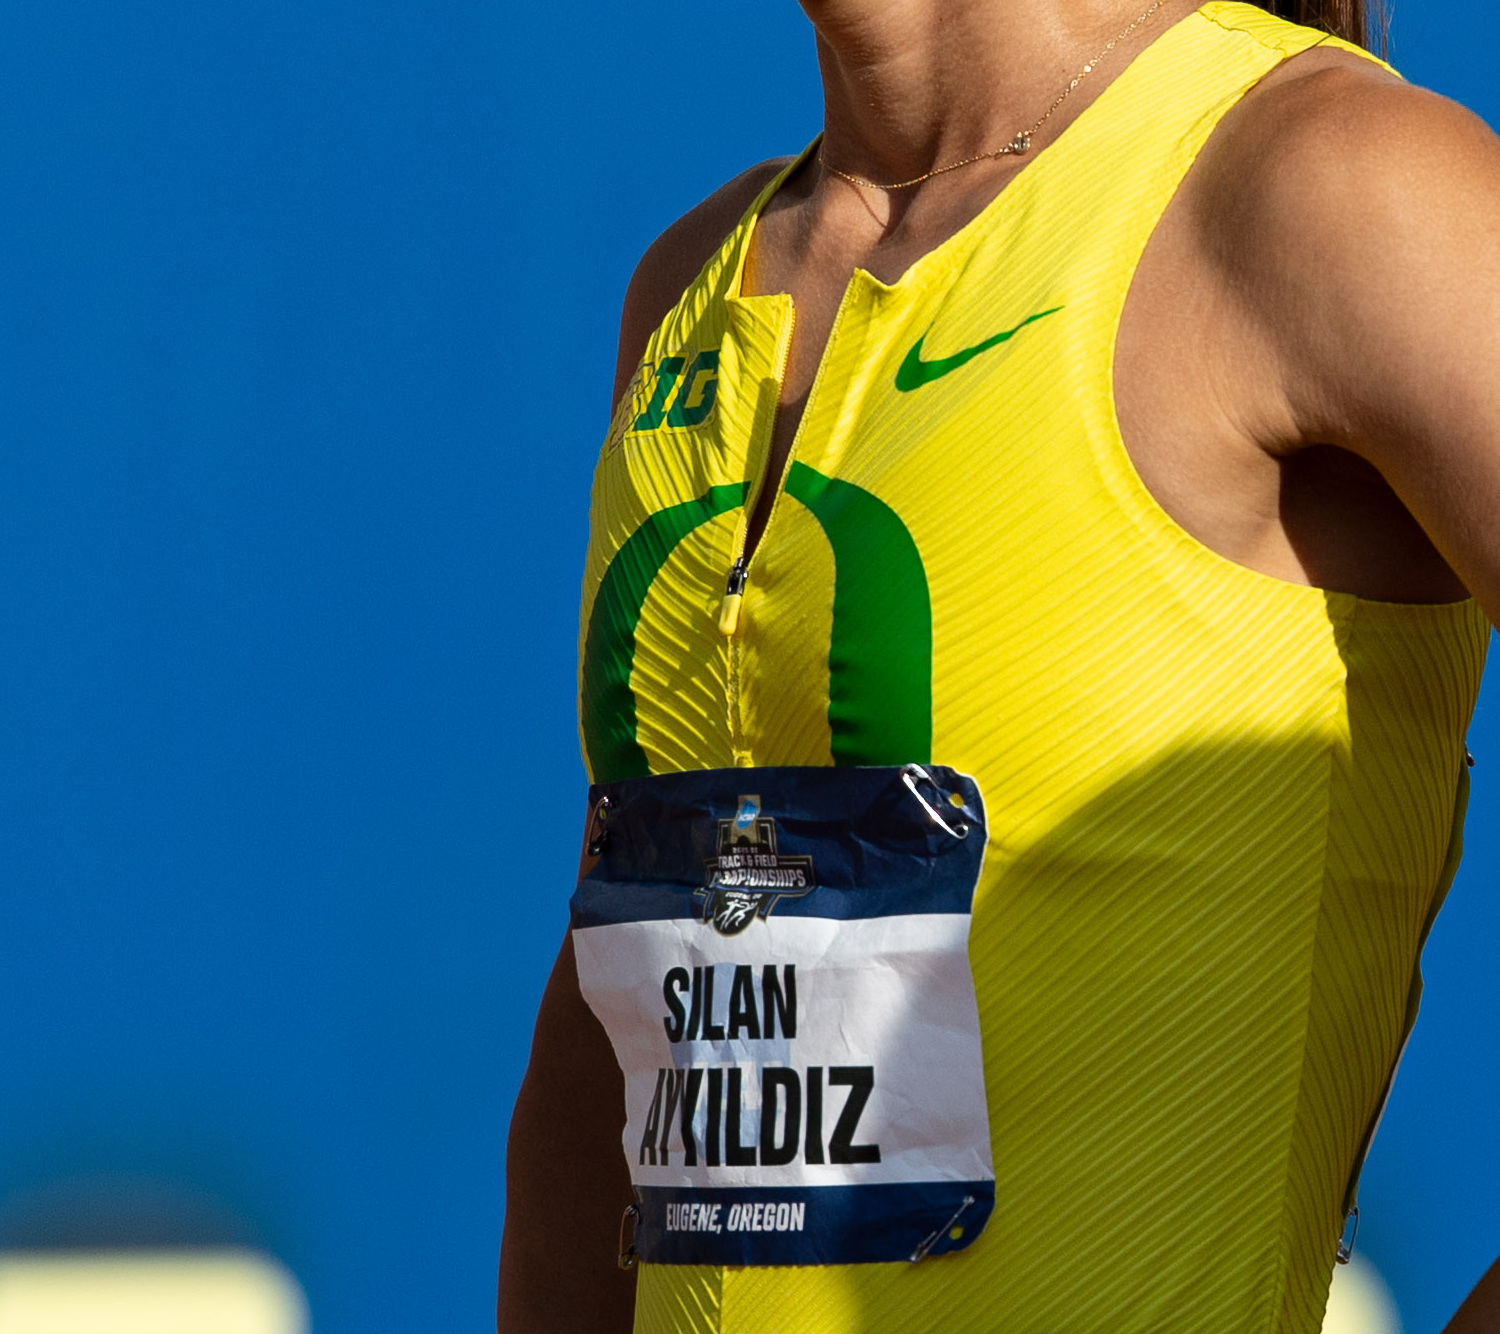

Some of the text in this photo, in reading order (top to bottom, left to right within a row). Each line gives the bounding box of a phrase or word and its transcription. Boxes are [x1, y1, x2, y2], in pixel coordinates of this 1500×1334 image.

[755, 854, 777, 867] FIELD
[663, 964, 797, 1044] SILAN
[639, 1065, 881, 1167] AYYILDIZ
[666, 1202, 806, 1235] EUGENE, OREGON
